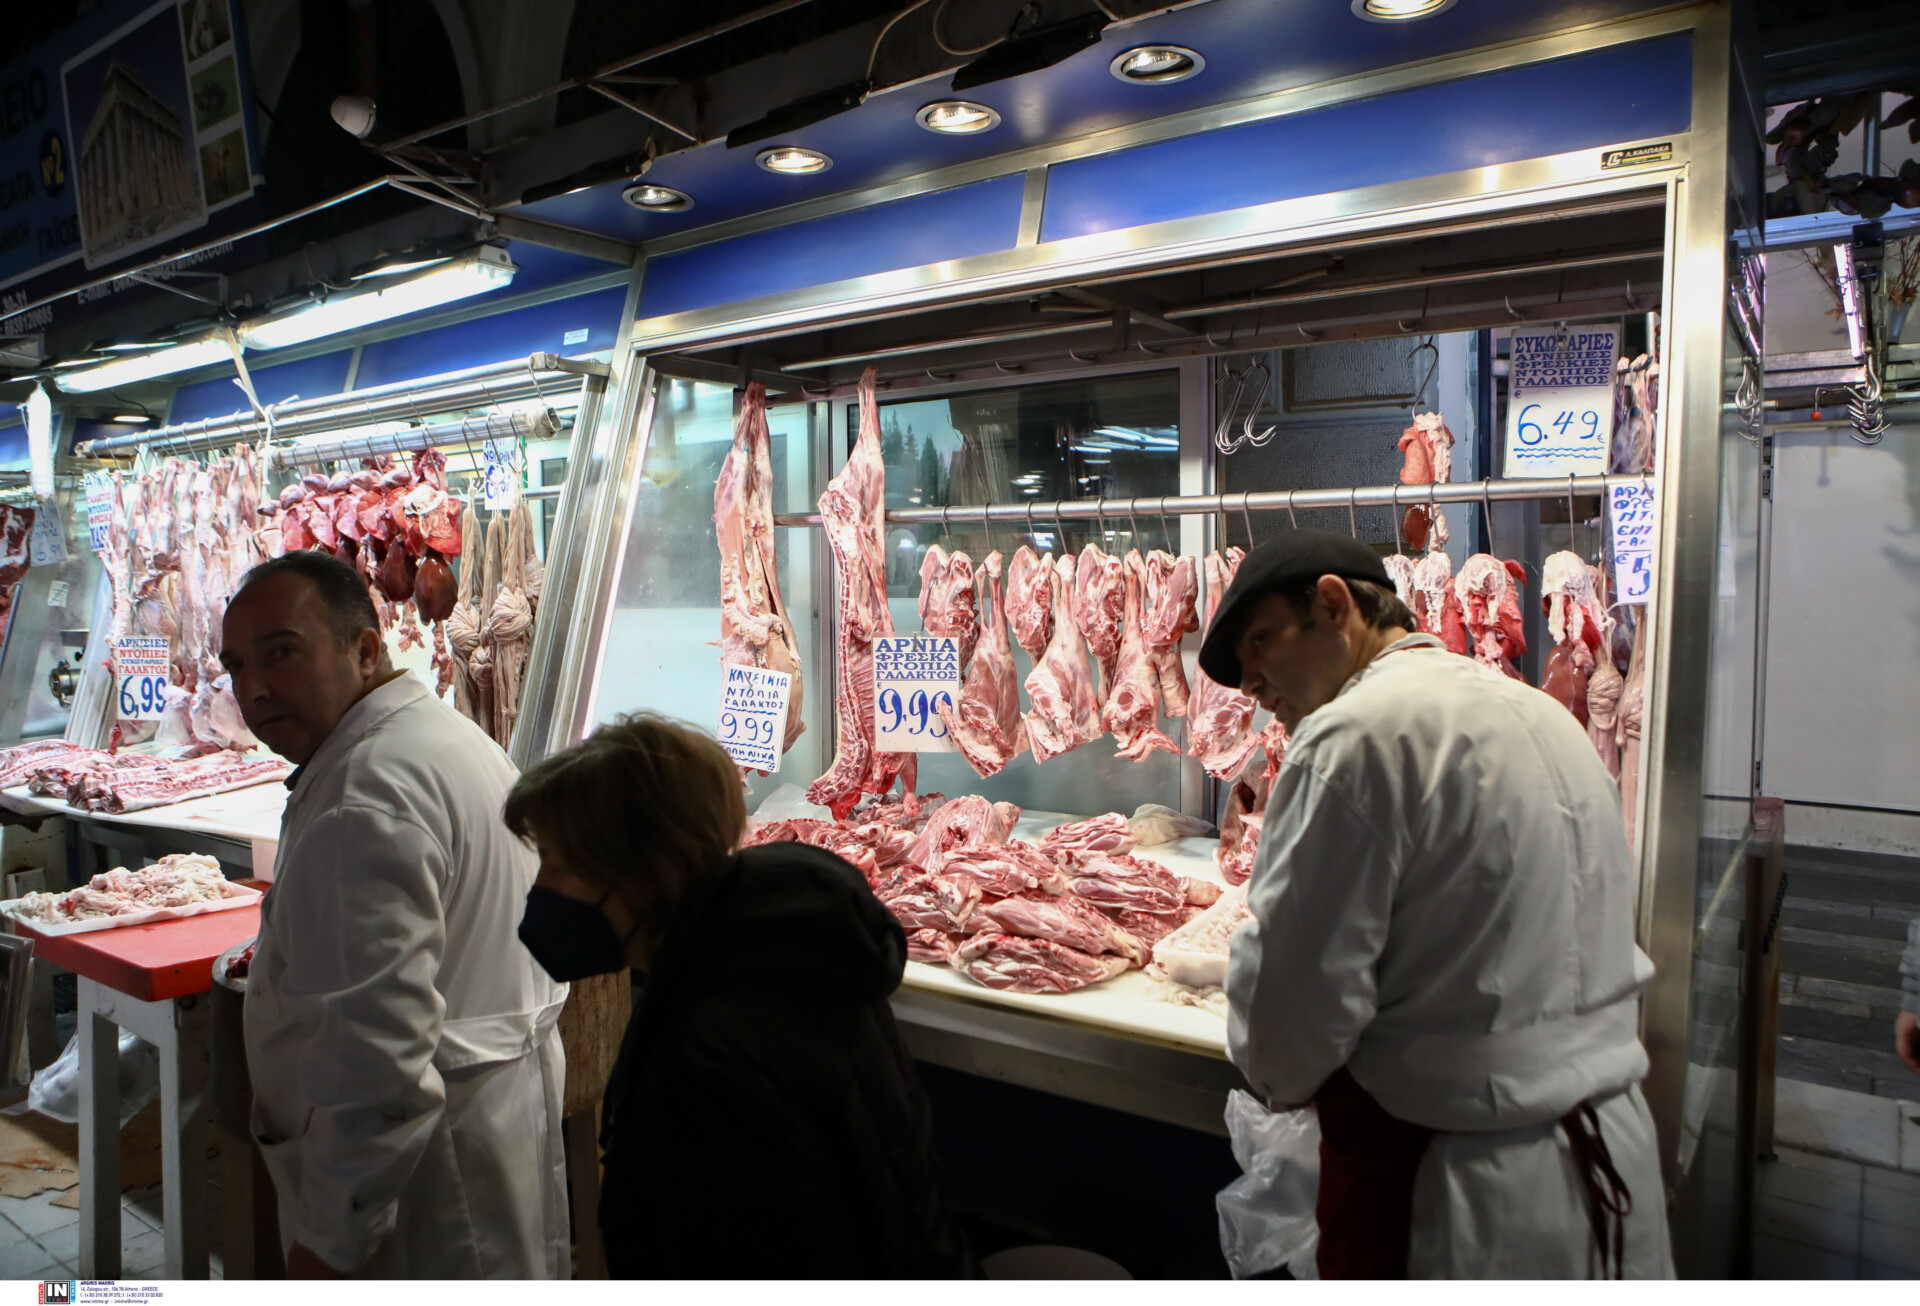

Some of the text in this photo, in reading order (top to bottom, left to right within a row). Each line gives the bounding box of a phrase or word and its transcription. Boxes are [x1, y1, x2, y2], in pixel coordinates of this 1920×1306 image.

[0, 67, 48, 140] ΕΙΟ
[1515, 351, 1611, 361] ΑΡΝΙΣΙΕΣ
[1515, 359, 1612, 369] ΦΡΕΣΚΙΕΣ
[1515, 367, 1611, 377] ΝΤΟΠΙΕΣ
[1515, 376, 1608, 386] ΓΑΛΑΚΤΟΣ
[1518, 404, 1599, 445] 6.49
[875, 638, 957, 653] ΑΡΝΙΑ
[119, 649, 168, 658] ΝΤΟΠΙΕΣ
[875, 652, 957, 662] ΦΡΕΣΚΑ
[118, 666, 168, 674] ΓΑΛΑΚΤΟΣ
[876, 661, 957, 671] ΝΤΟΠΙΑ
[876, 670, 957, 680] ΓΑΛΑΚΤΟΣ
[120, 675, 167, 719] 6,99
[879, 688, 953, 737] 9,99
[721, 712, 773, 744] 9.99
